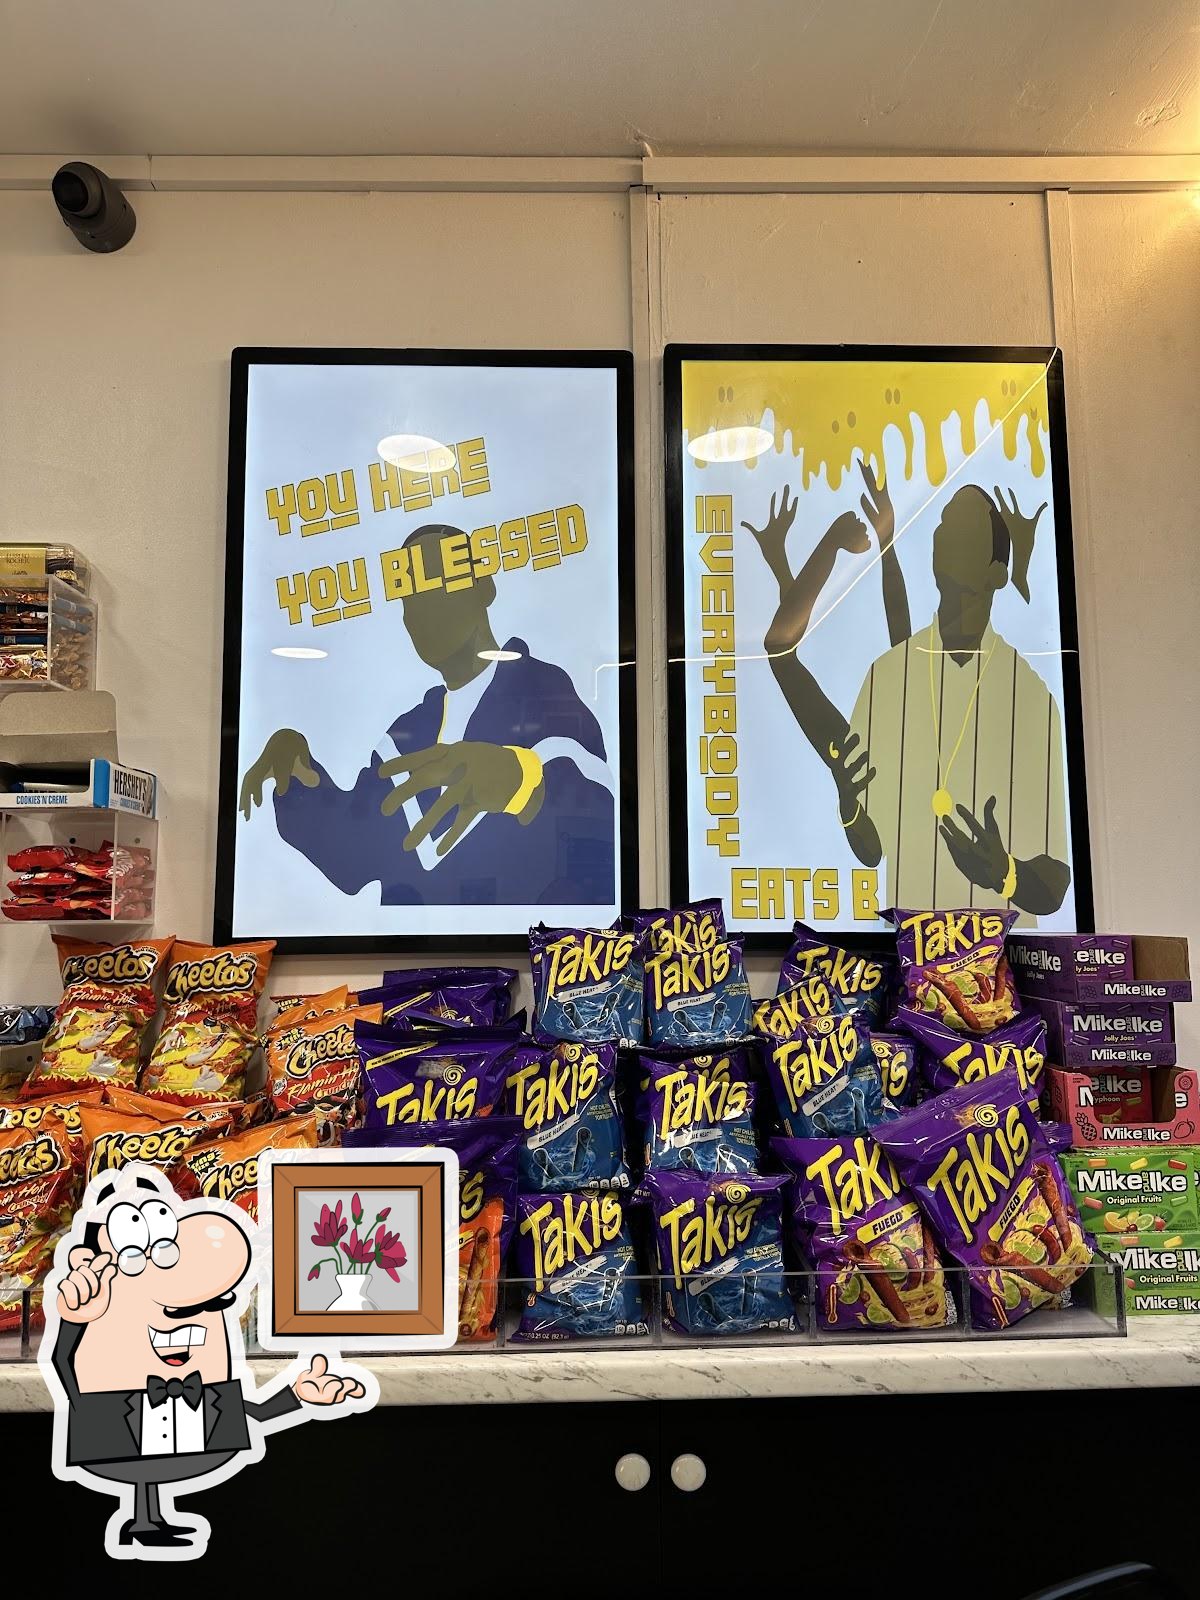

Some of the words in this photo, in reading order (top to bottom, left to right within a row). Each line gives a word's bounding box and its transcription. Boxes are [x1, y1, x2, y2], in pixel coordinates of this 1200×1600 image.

[265, 469, 360, 537] YOU
[368, 437, 491, 512] HERE
[275, 557, 372, 627] YOU
[380, 503, 588, 601] BLESSED
[696, 494, 740, 857] EVERYBODY
[16, 796, 40, 804] COOKIES
[48, 796, 68, 804] CREME
[731, 867, 839, 920] EATS
[901, 912, 1003, 966] Takis
[950, 951, 980, 969] FUEGO
[1009, 945, 1038, 965] Mike
[1042, 950, 1061, 971] Ike
[1095, 949, 1125, 965] Ike
[163, 952, 256, 1003] Cheetos
[545, 935, 635, 1000] Takis
[645, 943, 730, 1010] Takis
[1104, 984, 1140, 995] Mike
[1145, 985, 1166, 996] Ike
[753, 975, 830, 1039] Takis
[1073, 1015, 1126, 1031] Mike
[1131, 1017, 1162, 1032] Ike
[288, 1025, 357, 1075] Cheeto
[773, 1016, 858, 1113] Takis
[1091, 1049, 1126, 1060] Mike
[1131, 1050, 1151, 1060] Ike
[376, 1077, 478, 1125] Takis
[506, 1054, 599, 1130] Takis
[655, 1071, 748, 1140] Takis
[1107, 1075, 1141, 1093] Ike
[89, 1127, 191, 1183] Cheeto
[1104, 1127, 1142, 1140] Mike
[1148, 1129, 1171, 1141] Ike
[927, 1106, 1028, 1243] Takis
[1077, 1170, 1143, 1191] Mike
[1150, 1172, 1186, 1192] Ike
[872, 1212, 903, 1235] FUEGO
[1000, 1195, 1021, 1230] FUEGO
[1107, 1196, 1140, 1205] Original
[1141, 1195, 1162, 1203] Fruits
[520, 1191, 622, 1292] Takis
[660, 1196, 764, 1290] Takis
[1108, 1248, 1177, 1273] Mike
[1184, 1250, 1200, 1271] Ik
[1136, 1296, 1178, 1310] Mike
[1140, 1275, 1174, 1284] Original
[1176, 1274, 1198, 1282] Fruits
